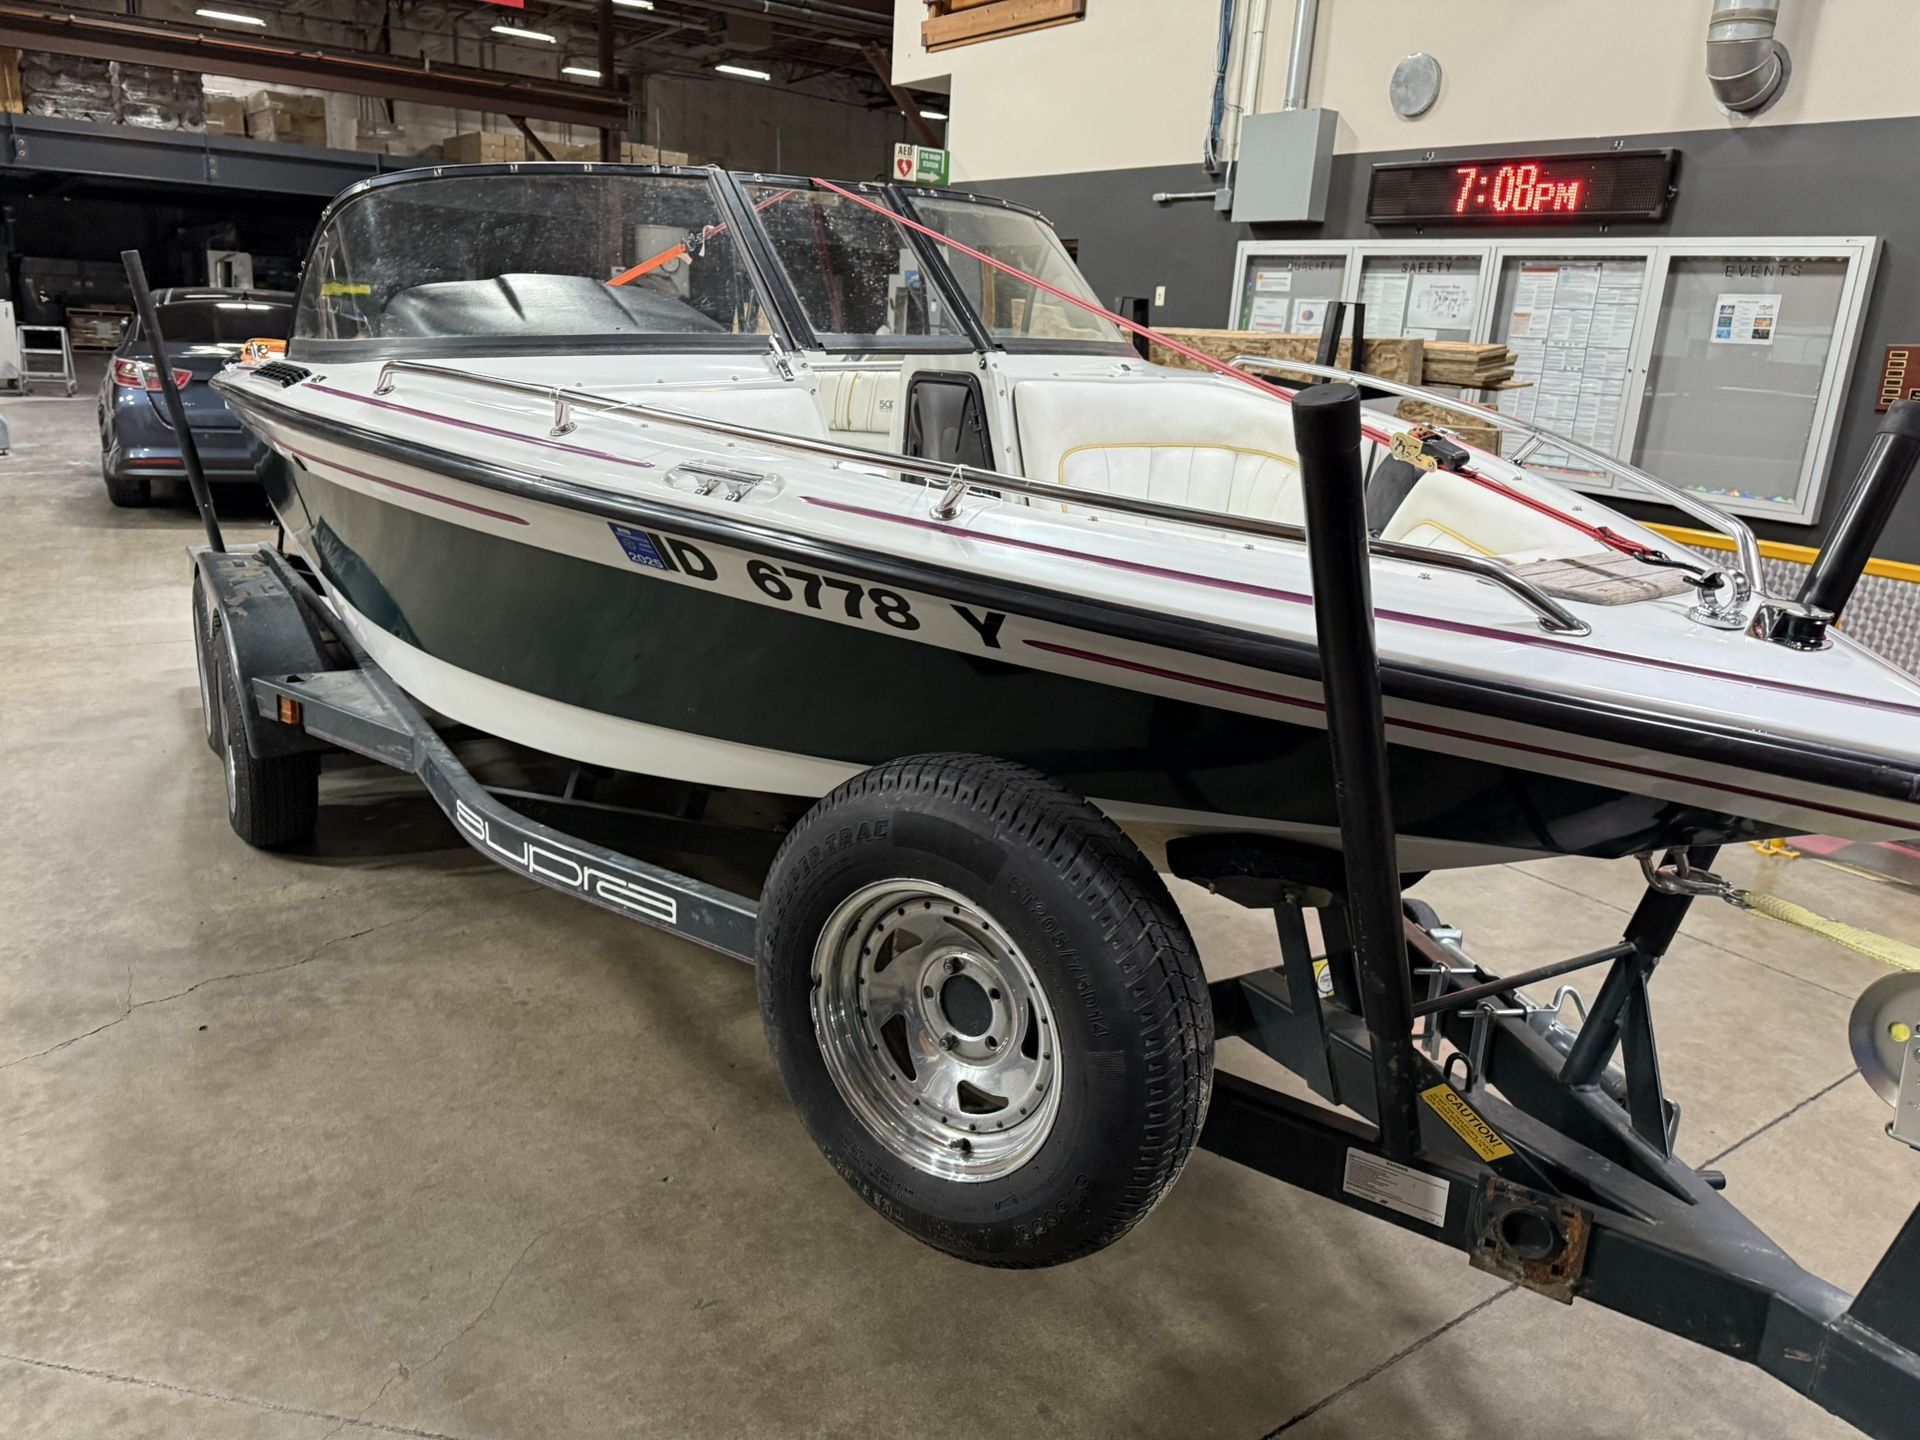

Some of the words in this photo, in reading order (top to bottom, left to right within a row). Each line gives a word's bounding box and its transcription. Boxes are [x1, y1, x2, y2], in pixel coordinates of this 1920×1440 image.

[898, 146, 912, 155] AED
[1287, 261, 1333, 272] QUALITY
[1401, 262, 1453, 273] SAFETY
[1725, 264, 1802, 278] EVENTS
[628, 551, 665, 569] 2025
[646, 531, 718, 582] ID
[746, 559, 921, 631] 6778
[949, 603, 1006, 649] Y
[824, 819, 889, 856] TRAC
[1445, 1092, 1502, 1147] CAUTION!
